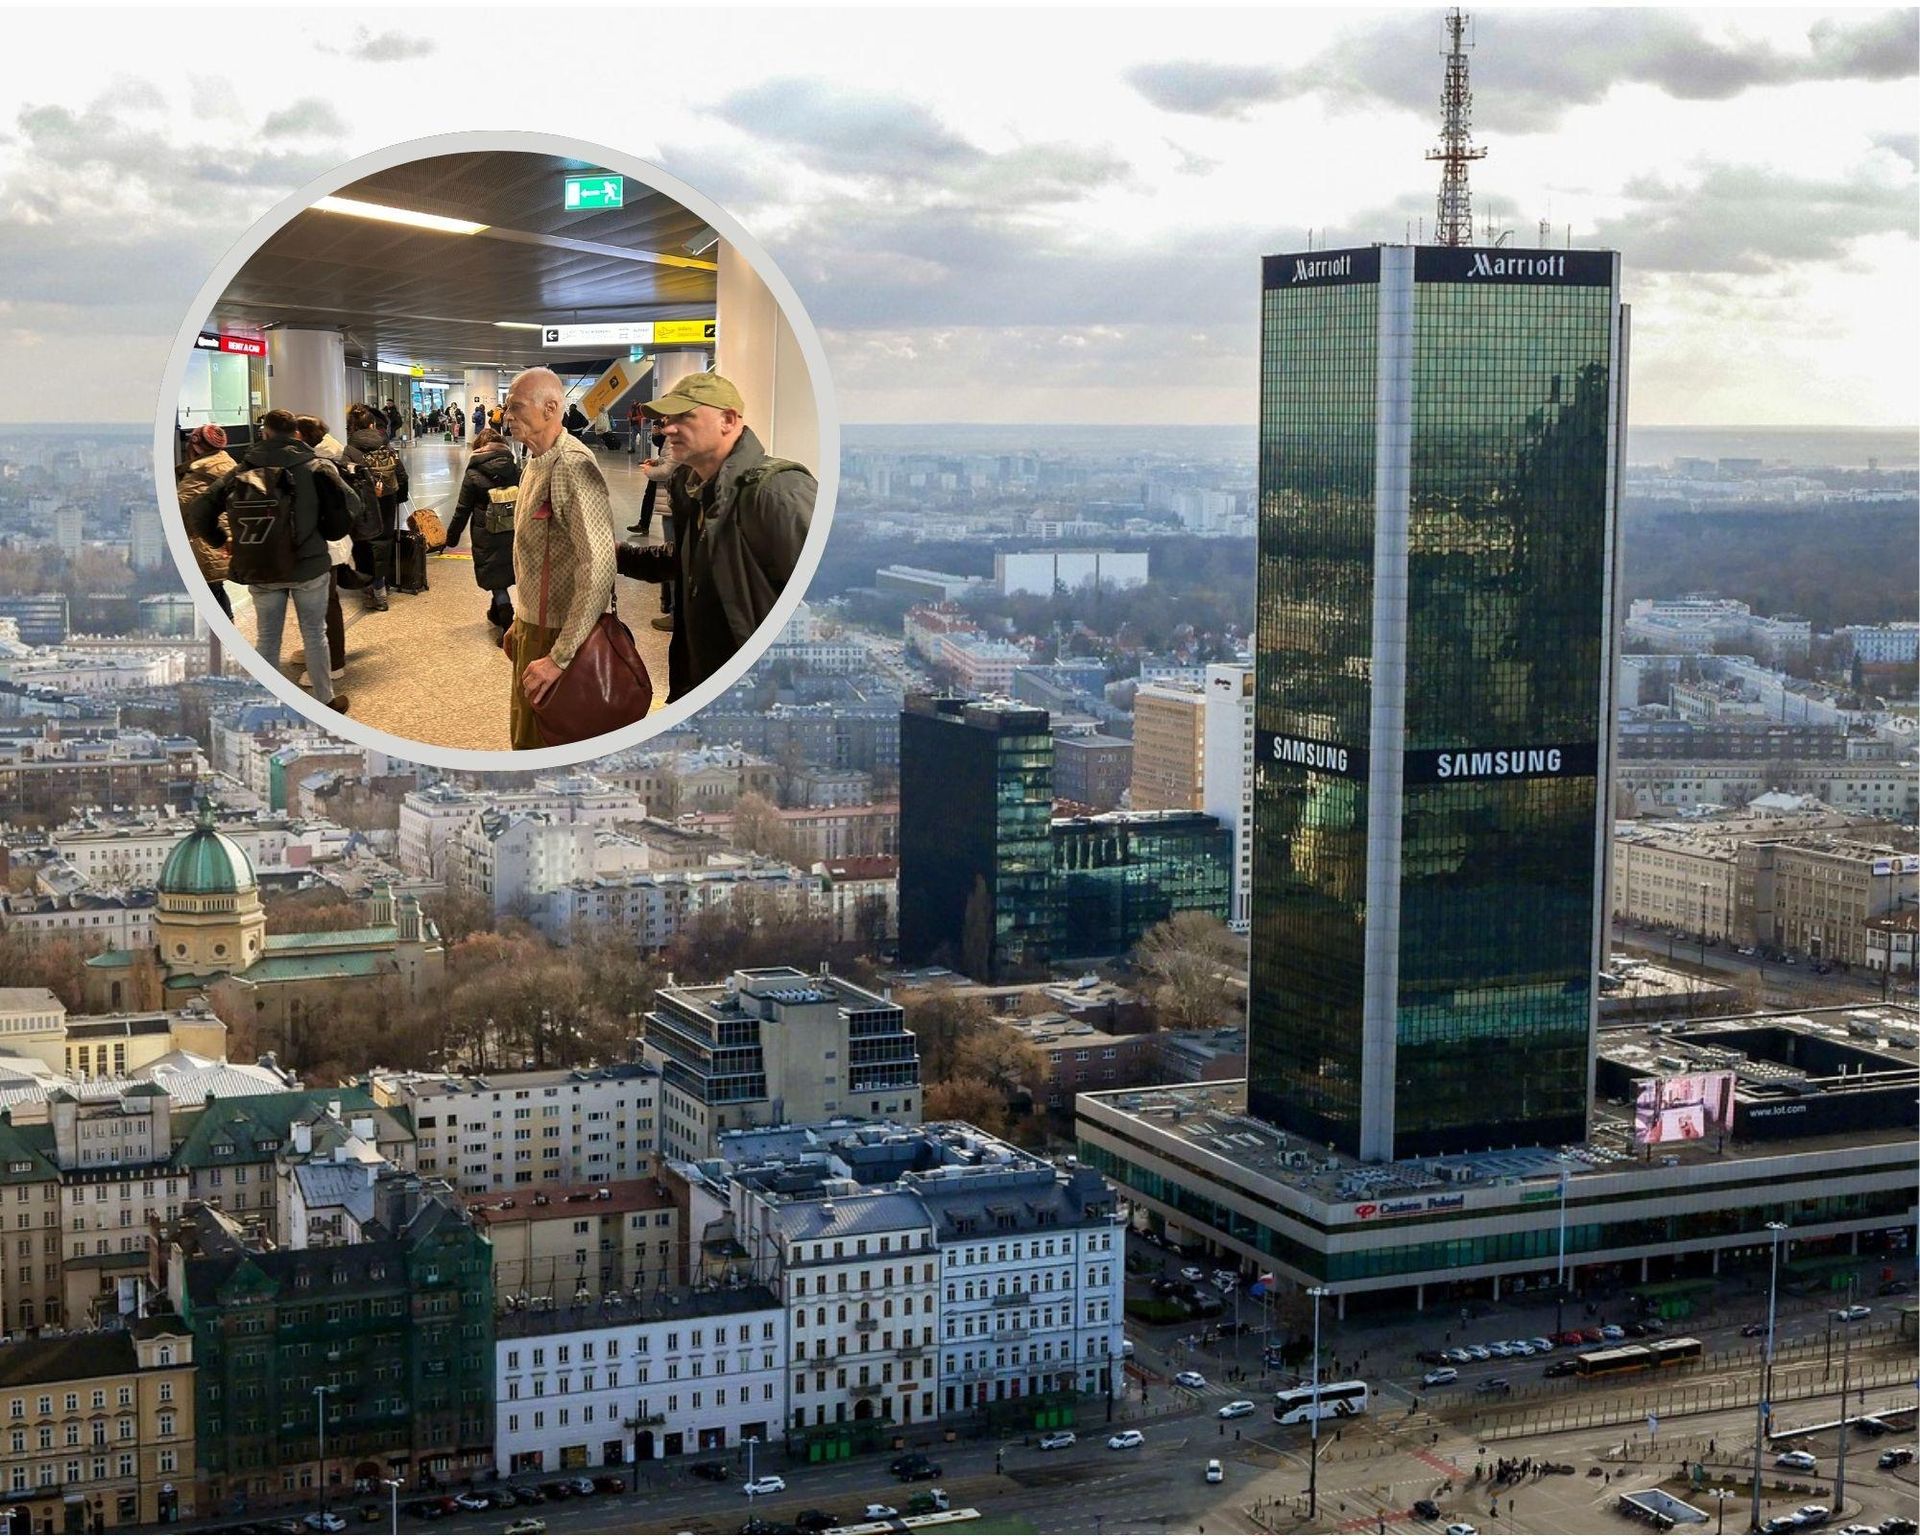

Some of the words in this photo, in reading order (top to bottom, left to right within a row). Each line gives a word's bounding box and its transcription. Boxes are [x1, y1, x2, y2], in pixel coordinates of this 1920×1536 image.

[1292, 255, 1352, 282] Marriott
[1467, 252, 1565, 277] Marriott
[1273, 736, 1348, 772] SAMSUNG
[1437, 749, 1562, 778] SAMSUNG
[1750, 1104, 1807, 1118] www.lot.com
